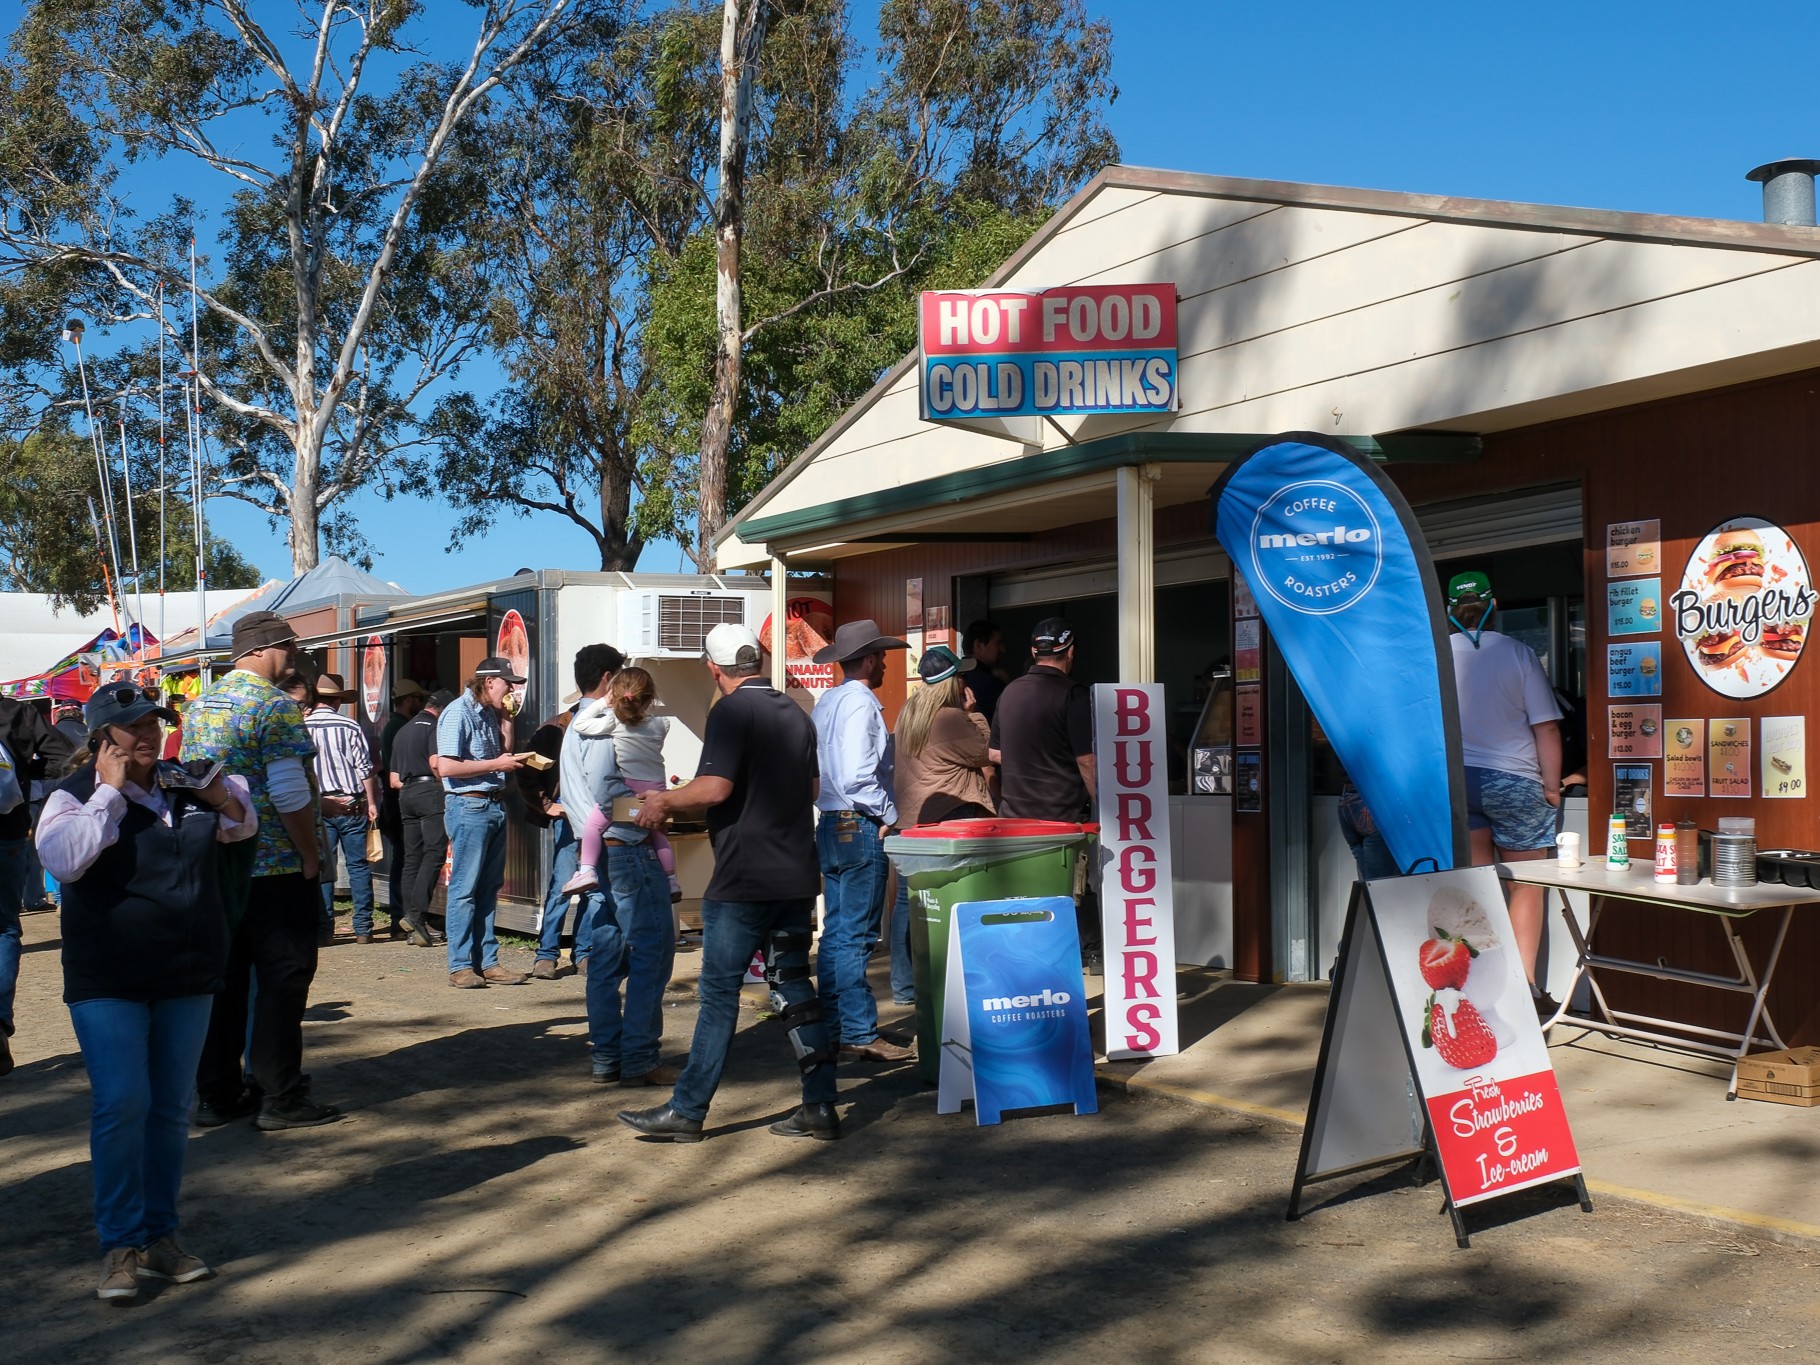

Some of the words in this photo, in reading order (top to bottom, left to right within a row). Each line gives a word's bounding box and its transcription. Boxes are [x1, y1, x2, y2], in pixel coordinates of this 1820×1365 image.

[940, 298, 1027, 345] HOT
[1042, 294, 1162, 342] FOOD
[929, 362, 1024, 412] COLD
[1034, 356, 1172, 410] DRINKS
[1284, 498, 1337, 517] COFFEE
[1259, 525, 1371, 549] merlo
[1610, 526, 1640, 536] chicken
[1610, 537, 1638, 547] burger
[1300, 554, 1315, 562] EST
[1316, 553, 1336, 561] 1992
[1284, 571, 1357, 597] ROASTERS
[1609, 588, 1619, 596] rib
[1621, 586, 1639, 596] fillet
[1610, 597, 1633, 607] burger
[1671, 585, 1815, 642] Burgers
[1610, 648, 1632, 657] angus
[1610, 656, 1627, 665] beef
[1610, 667, 1635, 676] burger
[1611, 710, 1633, 719] bacon
[1619, 721, 1632, 730] egg
[1611, 729, 1636, 739] burger
[1113, 688, 1163, 1052] BURGERS
[982, 989, 1071, 1011] merlo
[991, 1012, 1022, 1023] COFFEE
[1026, 1009, 1066, 1020] ROASTERS
[1464, 1075, 1501, 1102] Fresh
[1450, 1091, 1544, 1138] Strawberries
[1494, 1126, 1517, 1156] &
[1475, 1148, 1549, 1190] Ice-cream
